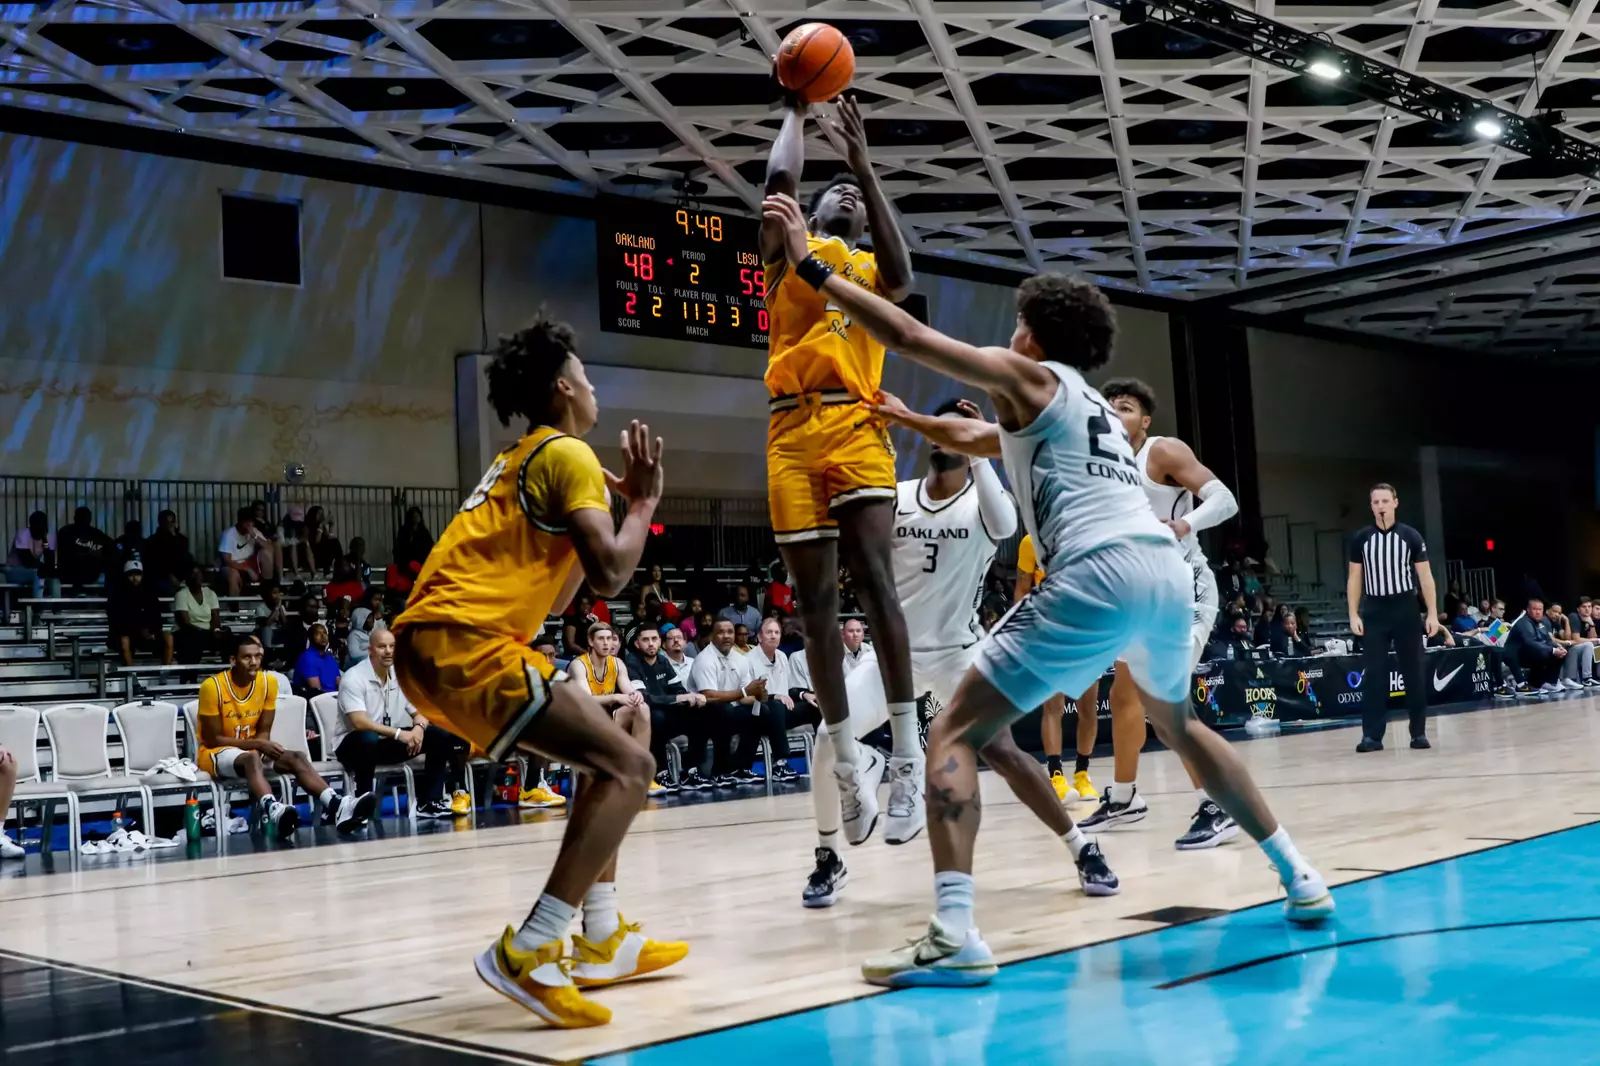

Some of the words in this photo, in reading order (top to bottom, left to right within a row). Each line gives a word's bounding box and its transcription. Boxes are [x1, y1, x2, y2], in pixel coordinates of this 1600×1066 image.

[676, 210, 723, 242] 9:48
[615, 232, 656, 250] OAKLAND
[682, 250, 706, 262] PERIOD
[737, 251, 759, 266] LBSU
[624, 252, 654, 281] 48
[690, 263, 699, 284] 2
[616, 280, 639, 292] FOULS
[647, 284, 666, 296] T.O.L.
[625, 292, 637, 315] 2
[674, 288, 699, 300] PLAYER
[701, 293, 719, 303] FOUL
[750, 298, 766, 309] FOUL
[652, 296, 662, 318] 2
[617, 317, 641, 329] SCORE
[730, 306, 740, 328] 3
[758, 310, 769, 331] 0
[686, 325, 709, 337] MATCH
[897, 526, 969, 539] OAKLAND
[922, 543, 939, 574] 3
[1244, 687, 1277, 703] HOOPS
